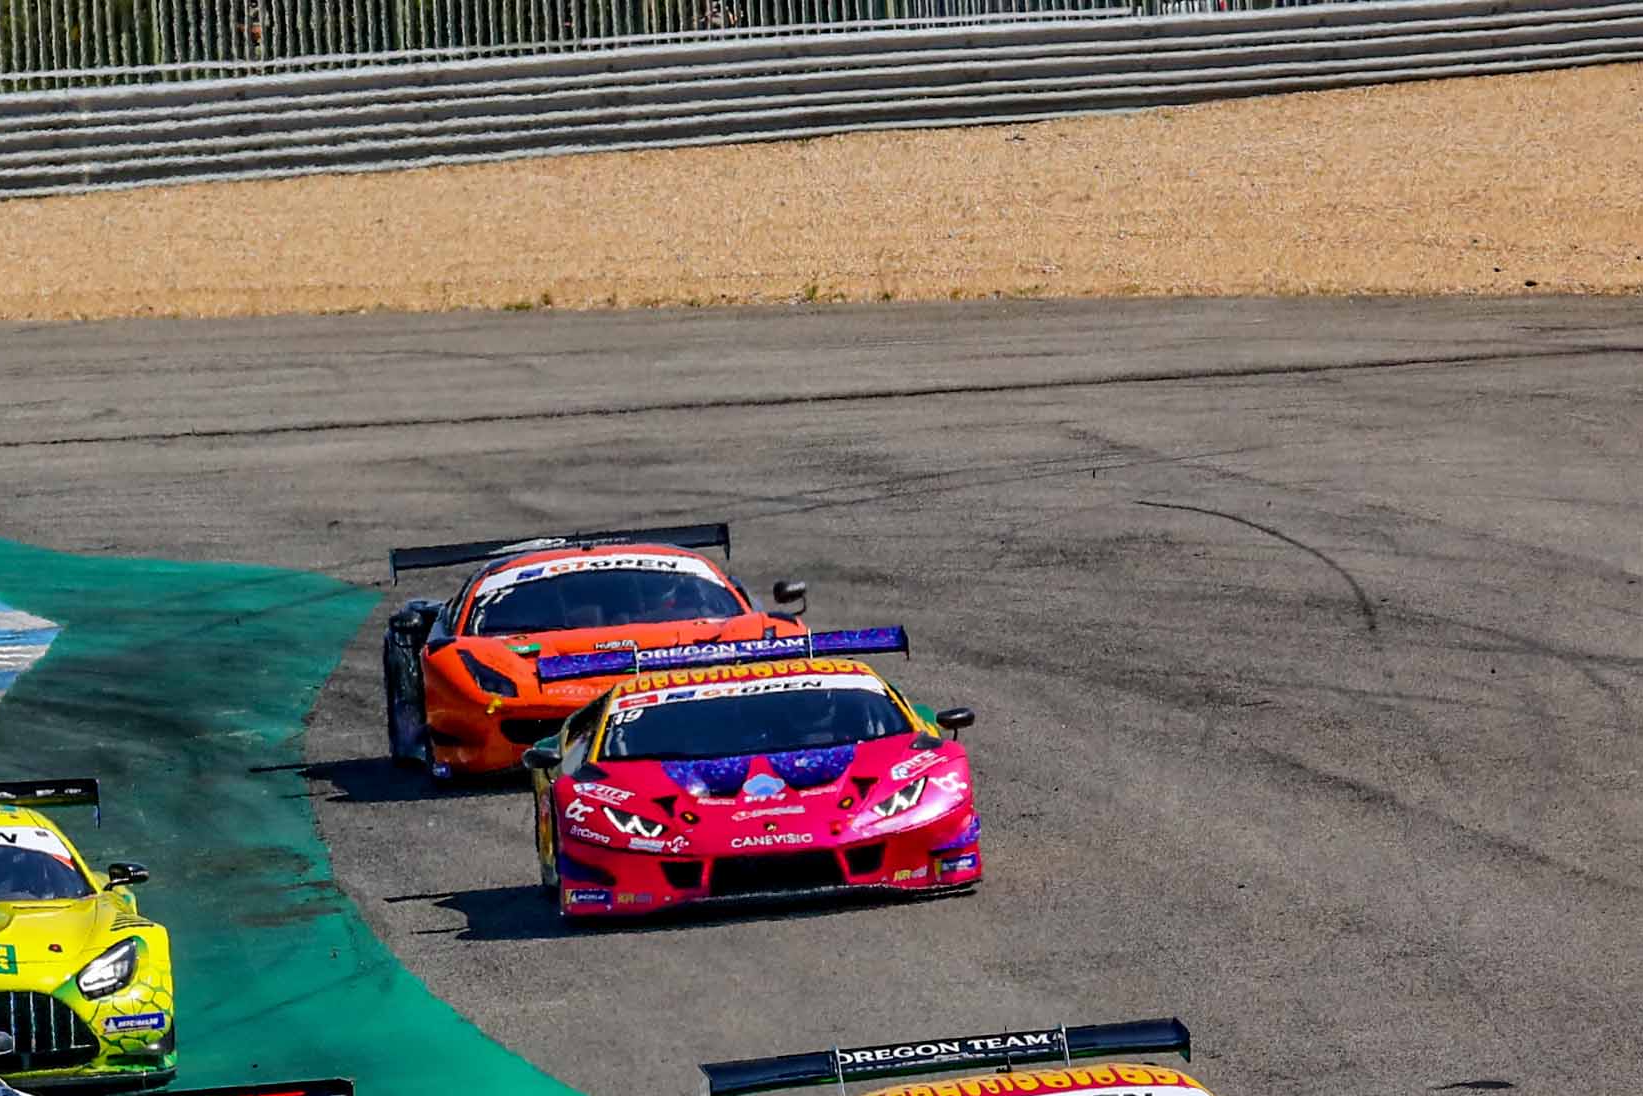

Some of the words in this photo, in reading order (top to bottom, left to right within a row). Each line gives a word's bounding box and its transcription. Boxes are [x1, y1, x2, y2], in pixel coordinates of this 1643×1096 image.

[549, 559, 678, 575] GTOPEN
[637, 643, 736, 661] OREGON
[739, 637, 807, 652] TEAM
[702, 679, 822, 698] GTOPEN
[613, 709, 644, 726] 19
[731, 833, 813, 848] CANEVISIO
[838, 1041, 959, 1065] OREGON
[967, 1032, 1051, 1050] TEAM
